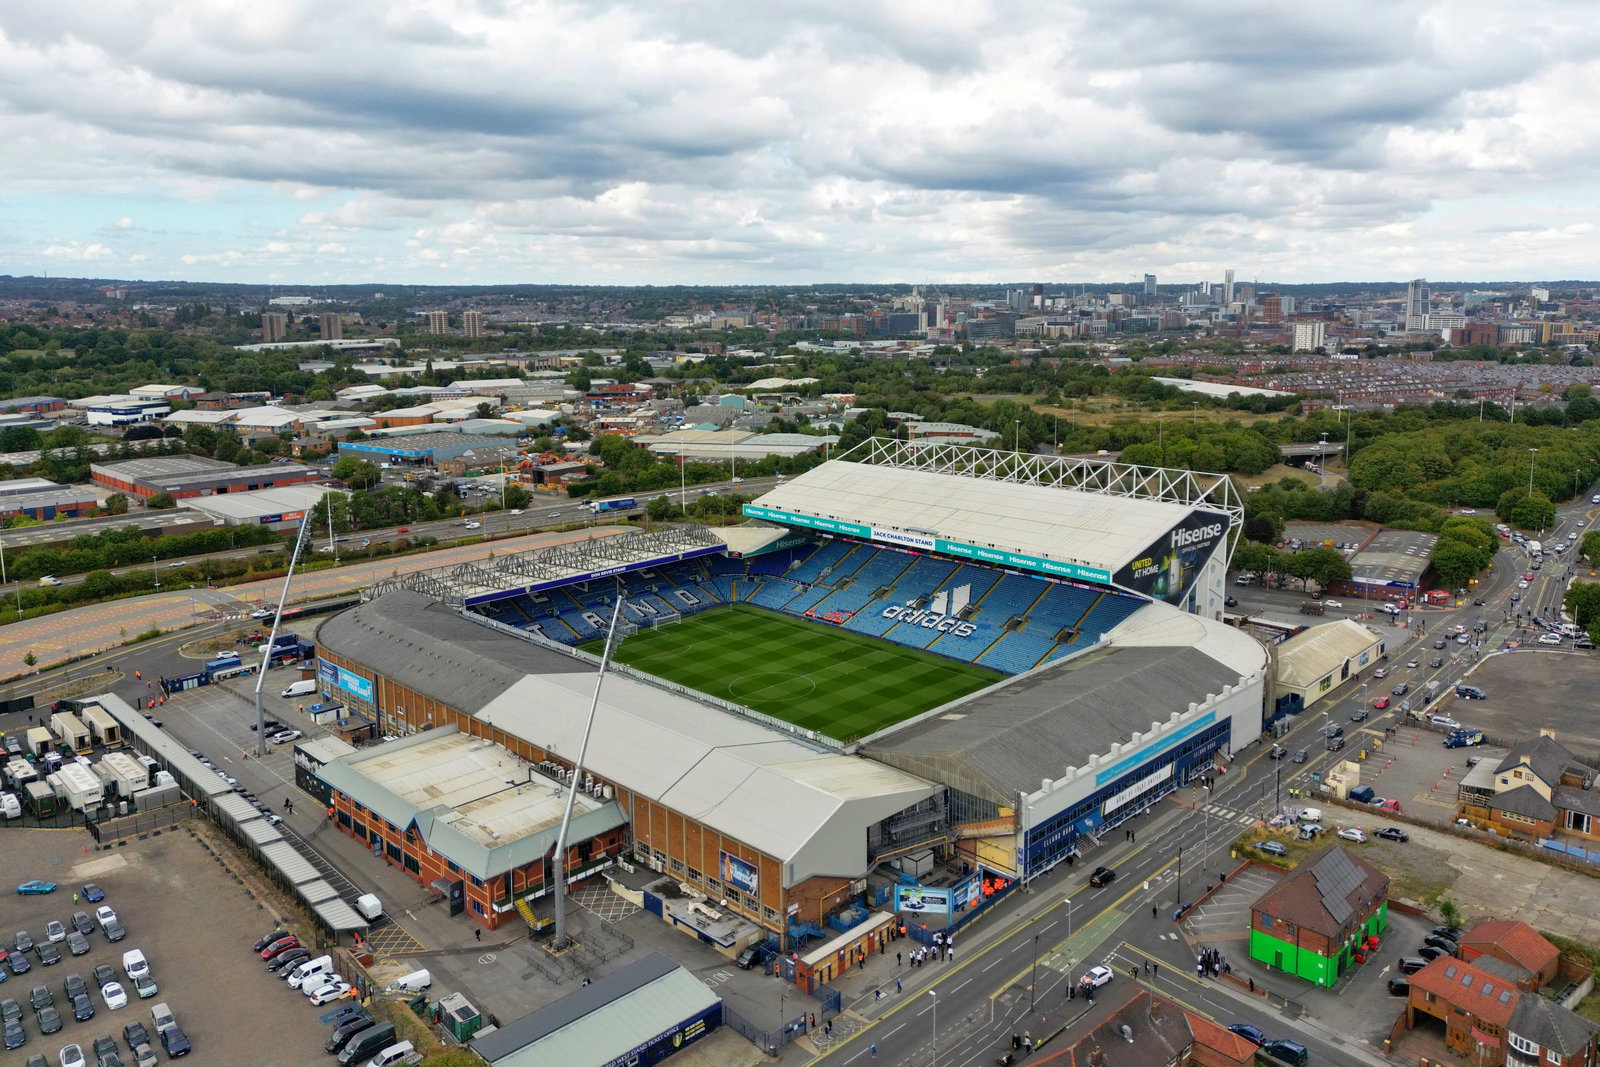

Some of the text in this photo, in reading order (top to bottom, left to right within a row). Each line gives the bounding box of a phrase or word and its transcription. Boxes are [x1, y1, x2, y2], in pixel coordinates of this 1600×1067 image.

[745, 508, 764, 517] Hisense
[767, 512, 787, 520] Hisense
[790, 515, 810, 525] Hisense
[814, 519, 835, 529] Hisense
[839, 524, 860, 534] Hisense
[873, 531, 933, 547] JACK CHARLTON STAND
[1170, 522, 1222, 549] Hisense
[776, 537, 806, 549] Hisense
[947, 544, 972, 554] Hisense
[1181, 541, 1211, 554] OFFICIAL PARTNER
[977, 550, 1004, 561] Hisense
[1009, 555, 1037, 567] Hisense
[1042, 561, 1072, 574] Hisense
[1131, 557, 1152, 570] UNITED
[613, 566, 627, 575] STAND
[1077, 568, 1108, 580] Hisense
[1134, 564, 1159, 579] AT HOME
[882, 605, 977, 638] adidas
[1043, 824, 1074, 847] ELLAND ROAD
[617, 1053, 630, 1063] WEST
[630, 1044, 647, 1056] STAND
[648, 1035, 663, 1046] TICKET
[663, 1025, 680, 1038] OFFICE
